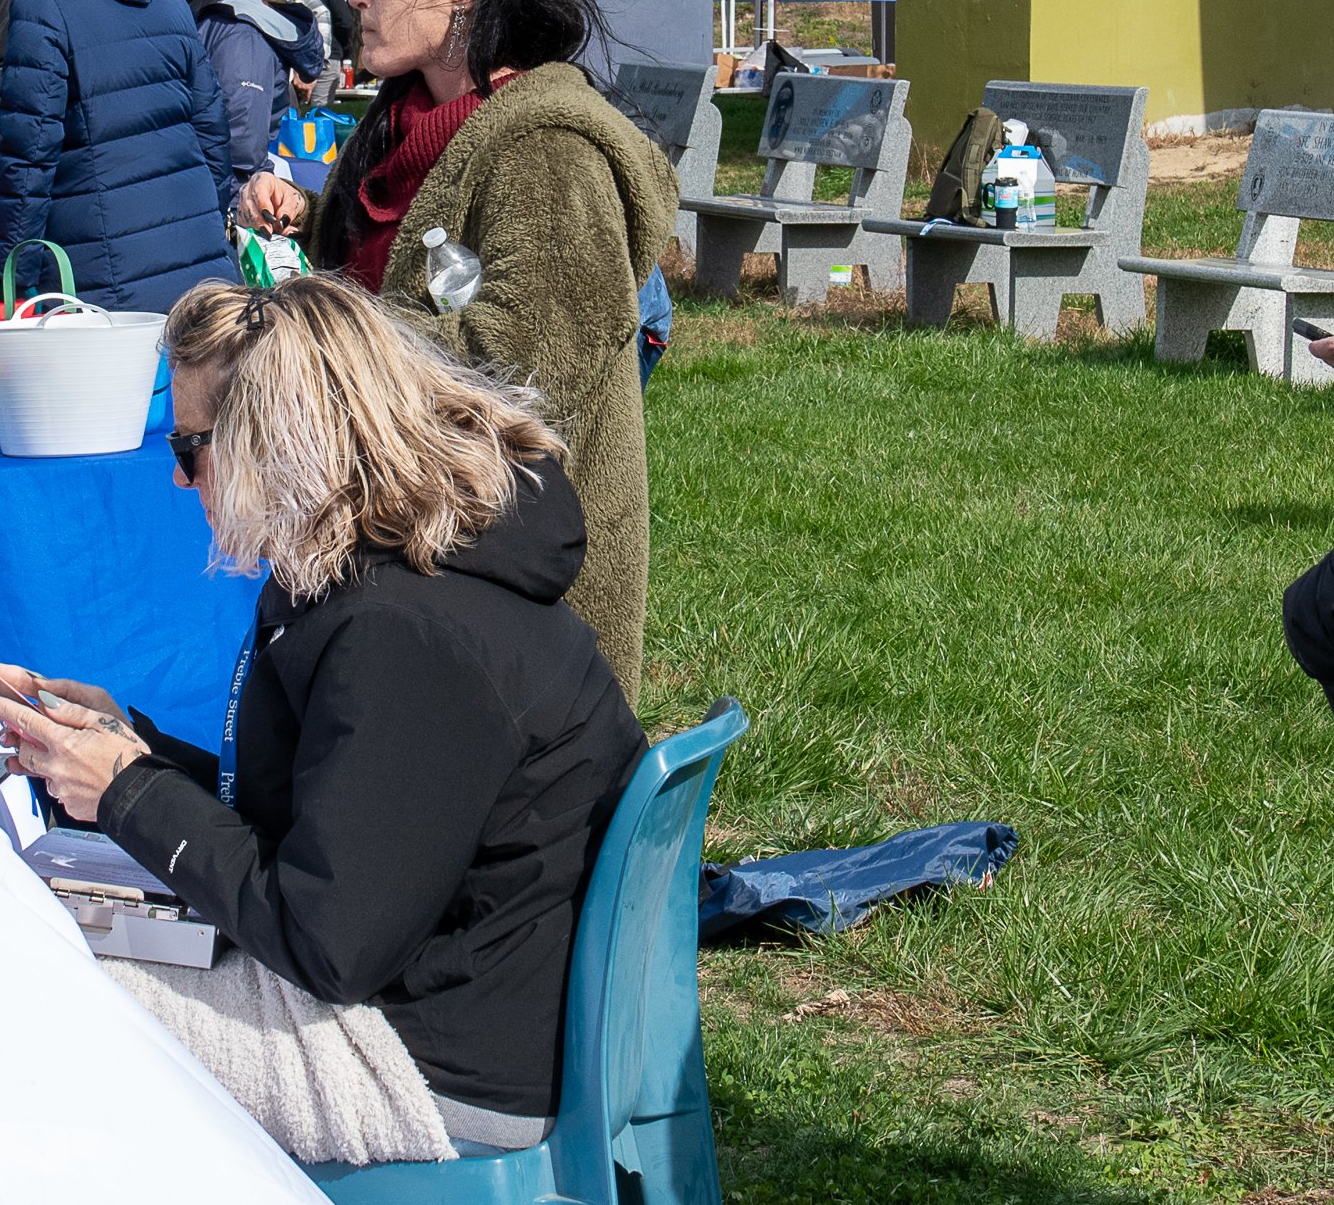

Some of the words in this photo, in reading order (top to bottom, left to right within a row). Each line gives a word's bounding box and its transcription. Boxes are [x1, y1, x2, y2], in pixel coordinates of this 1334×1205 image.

[231, 650, 250, 694] Preble
[224, 699, 238, 742] Street
[168, 839, 187, 874] DRYVENT
